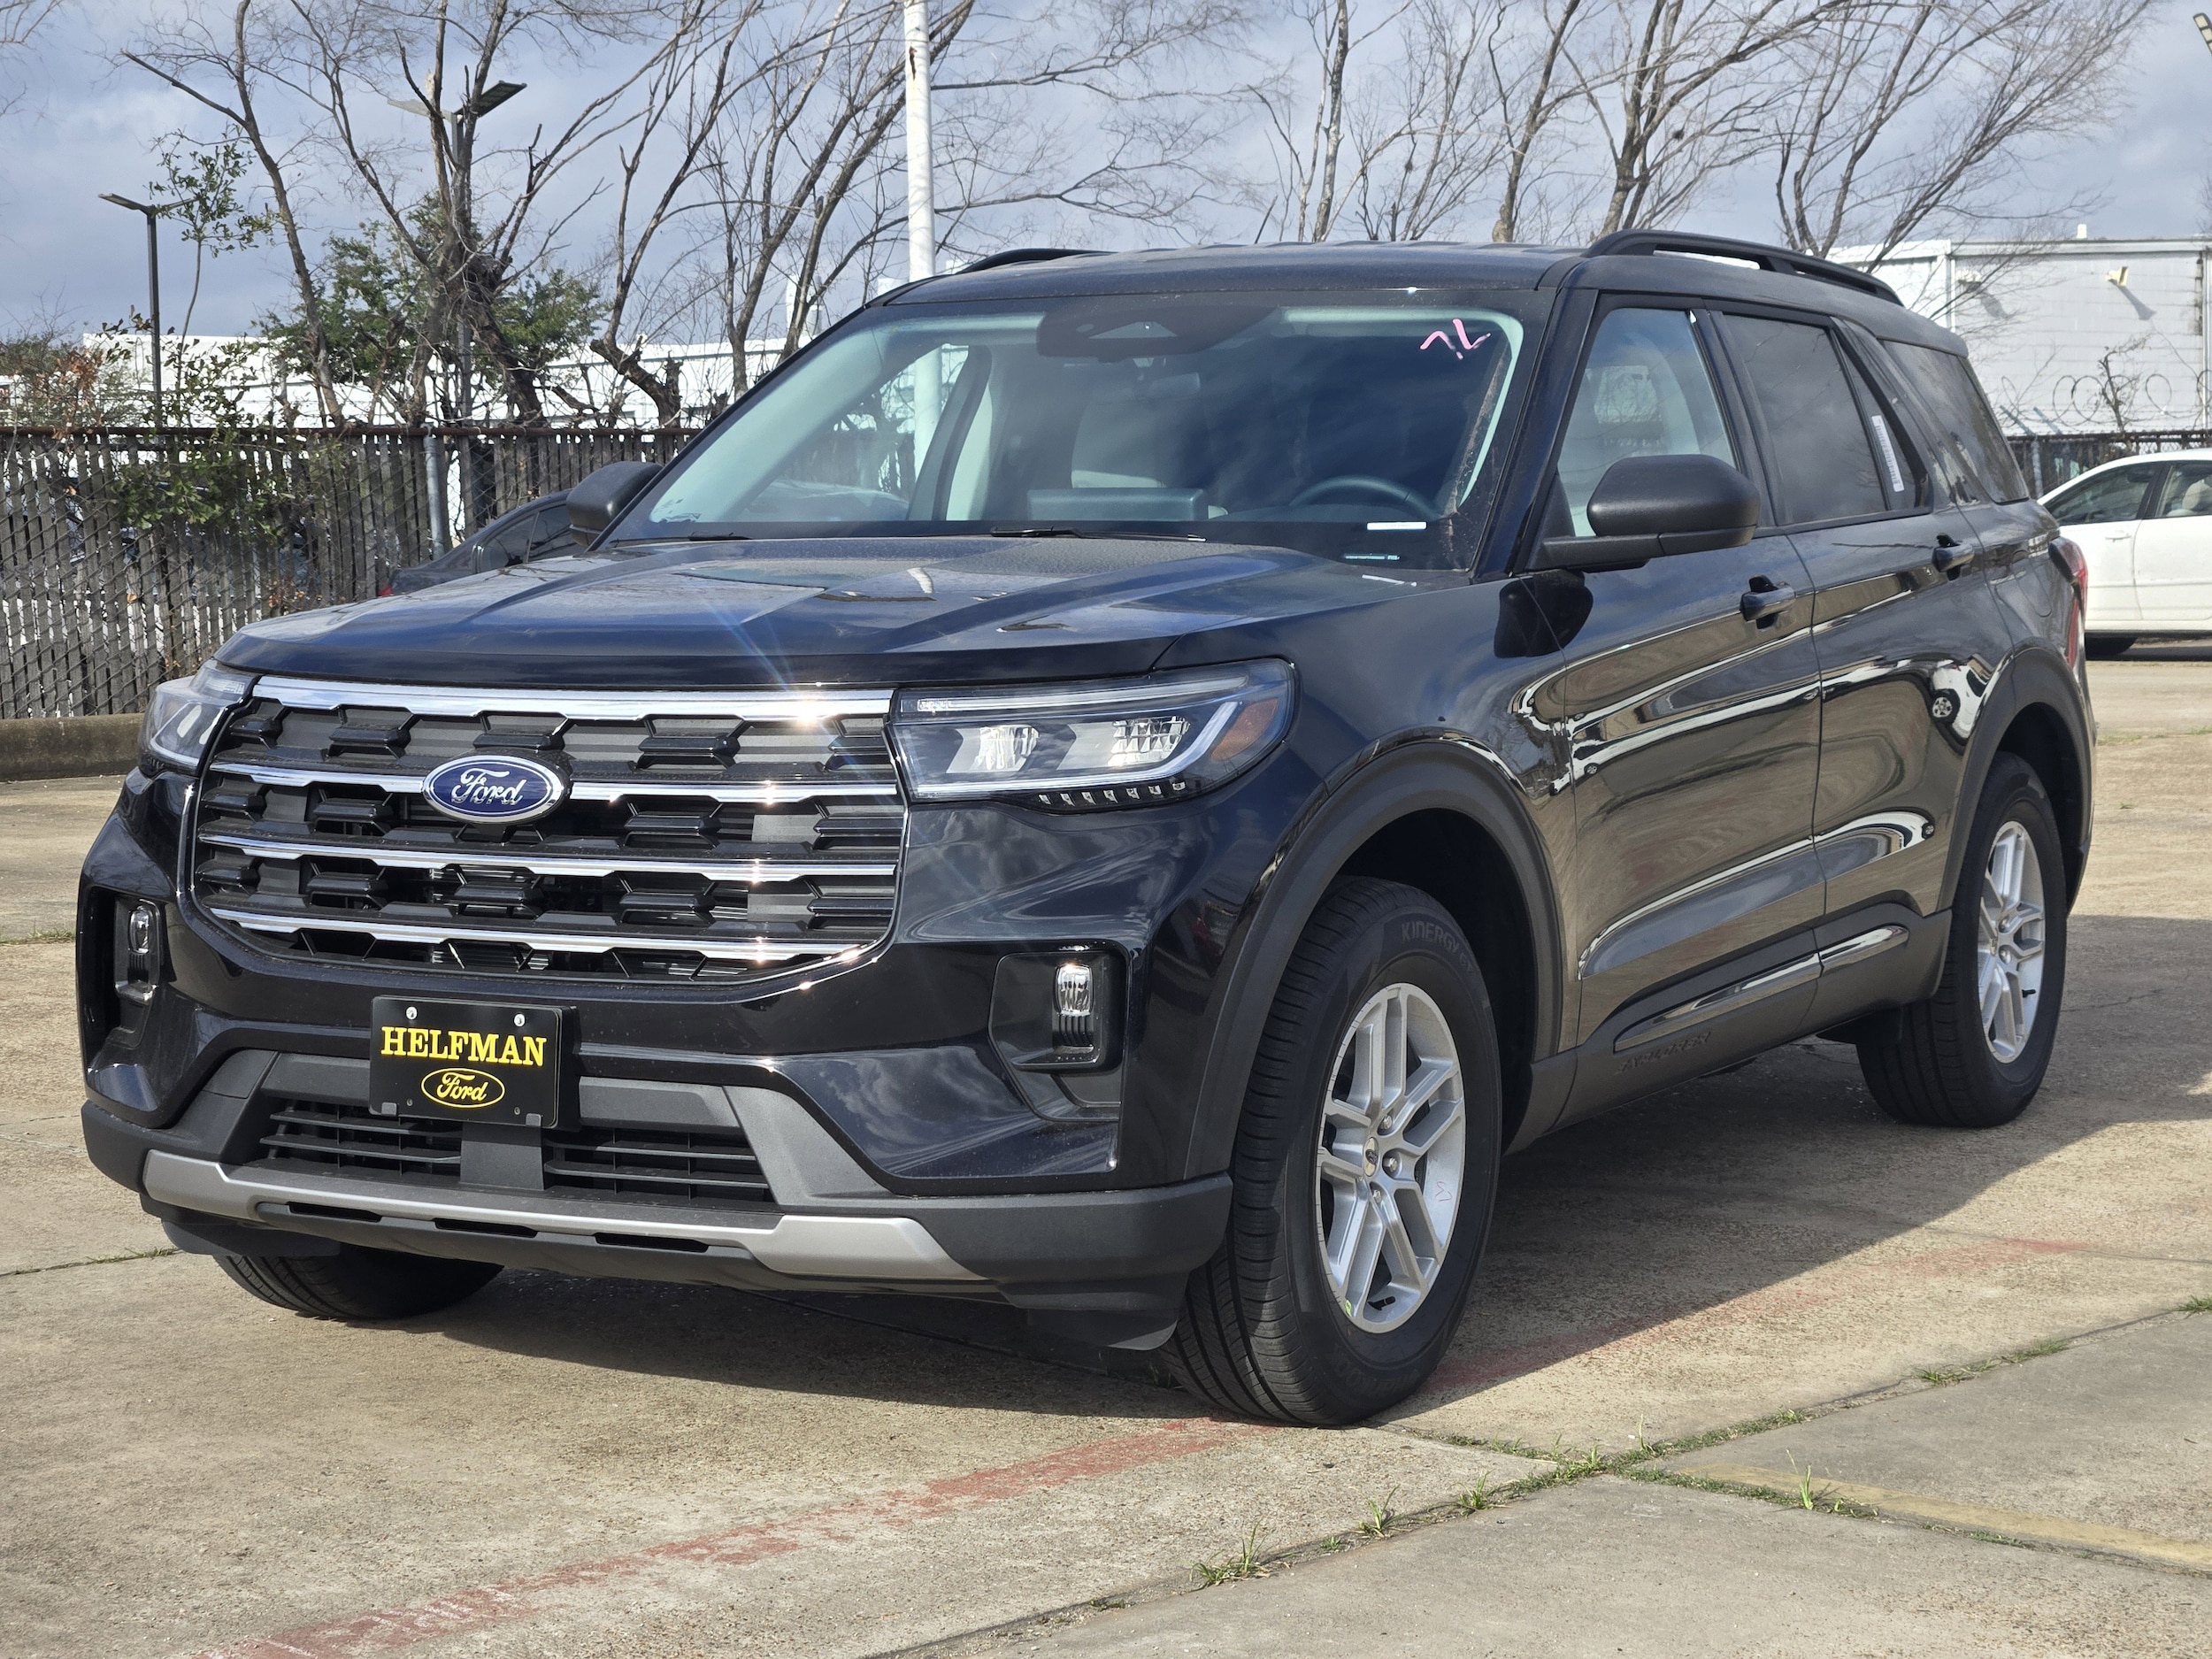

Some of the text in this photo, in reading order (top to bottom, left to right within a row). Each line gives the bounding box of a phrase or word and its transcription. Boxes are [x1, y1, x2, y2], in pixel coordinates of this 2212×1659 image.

[451, 767, 526, 805] Ford
[1401, 920, 1460, 953] KINERGY
[380, 1026, 547, 1067] HELFMAN
[436, 1071, 488, 1102] Ford
